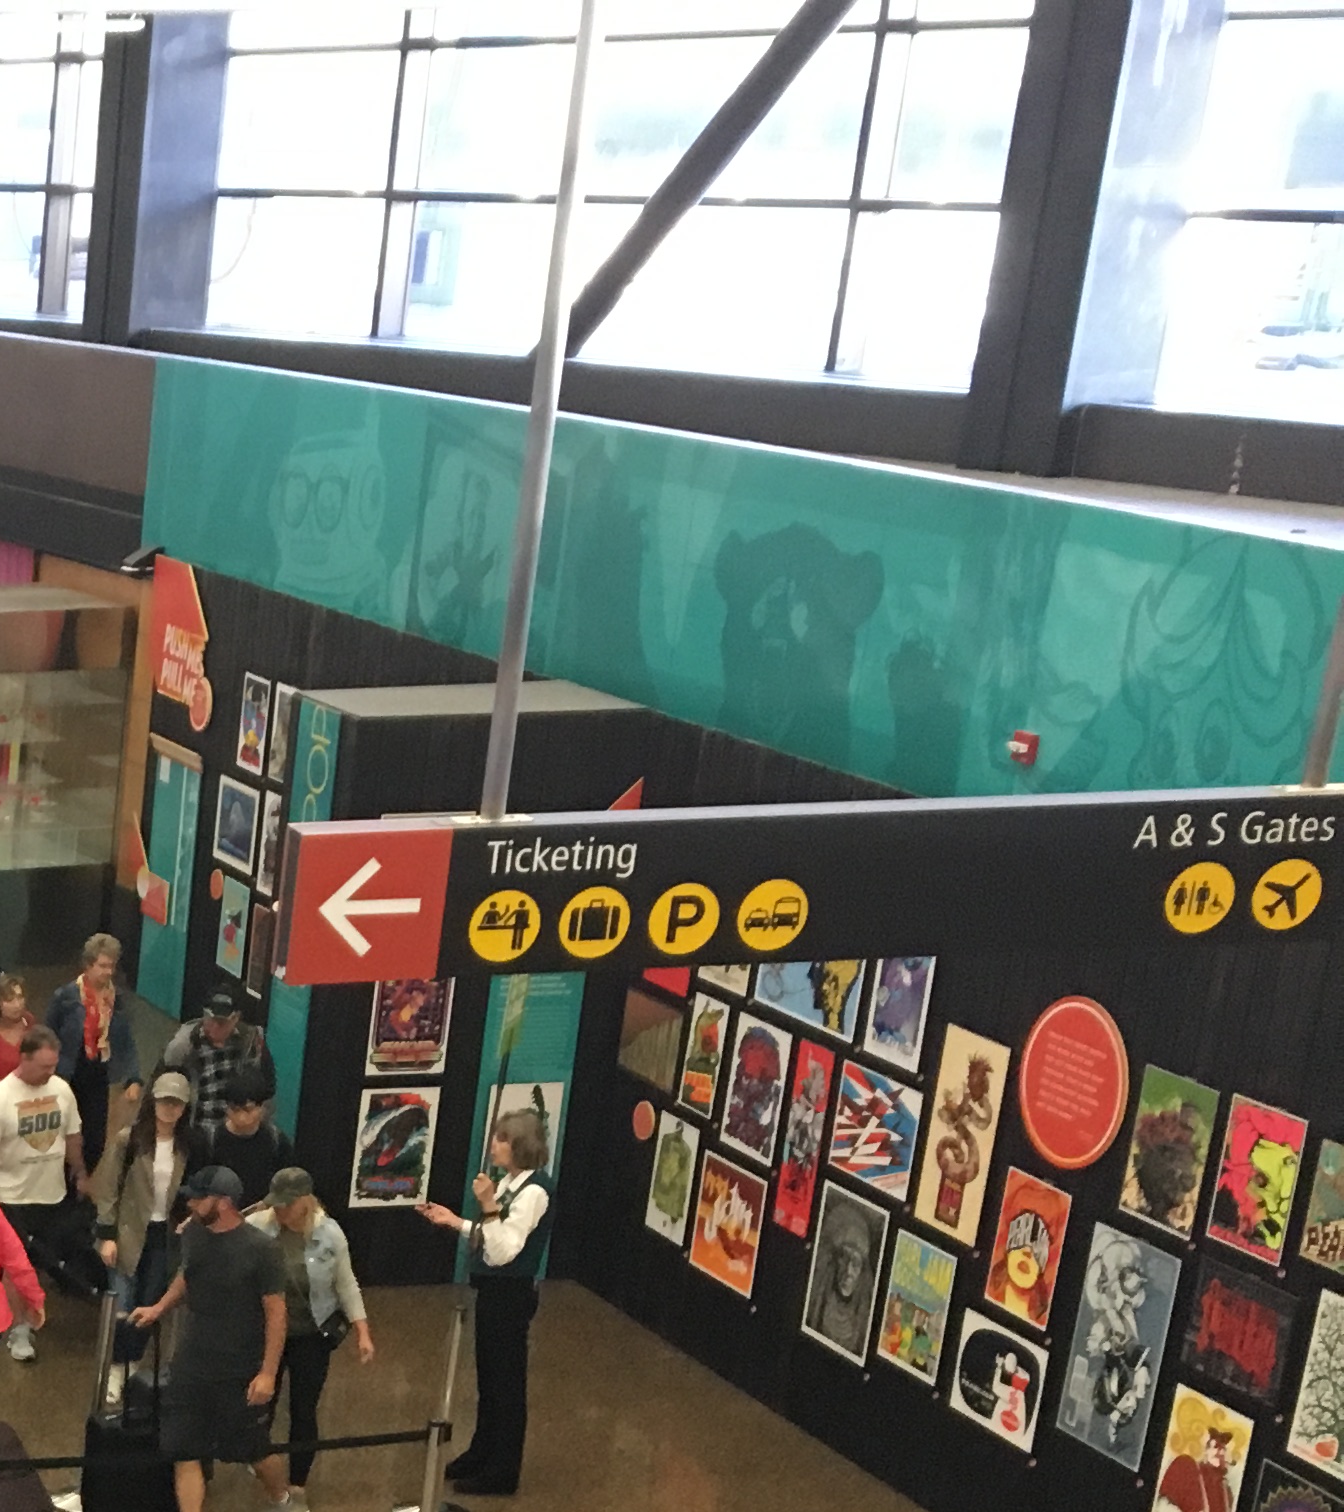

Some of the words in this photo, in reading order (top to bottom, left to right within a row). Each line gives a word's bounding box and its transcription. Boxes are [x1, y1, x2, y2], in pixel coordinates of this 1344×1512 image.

[163, 623, 189, 660] PUSH
[1132, 815, 1158, 849] A
[1170, 813, 1195, 847] &
[1207, 812, 1228, 846] S
[1240, 810, 1336, 845] Gates
[487, 836, 638, 878] Ticketing
[18, 1110, 62, 1137] 500
